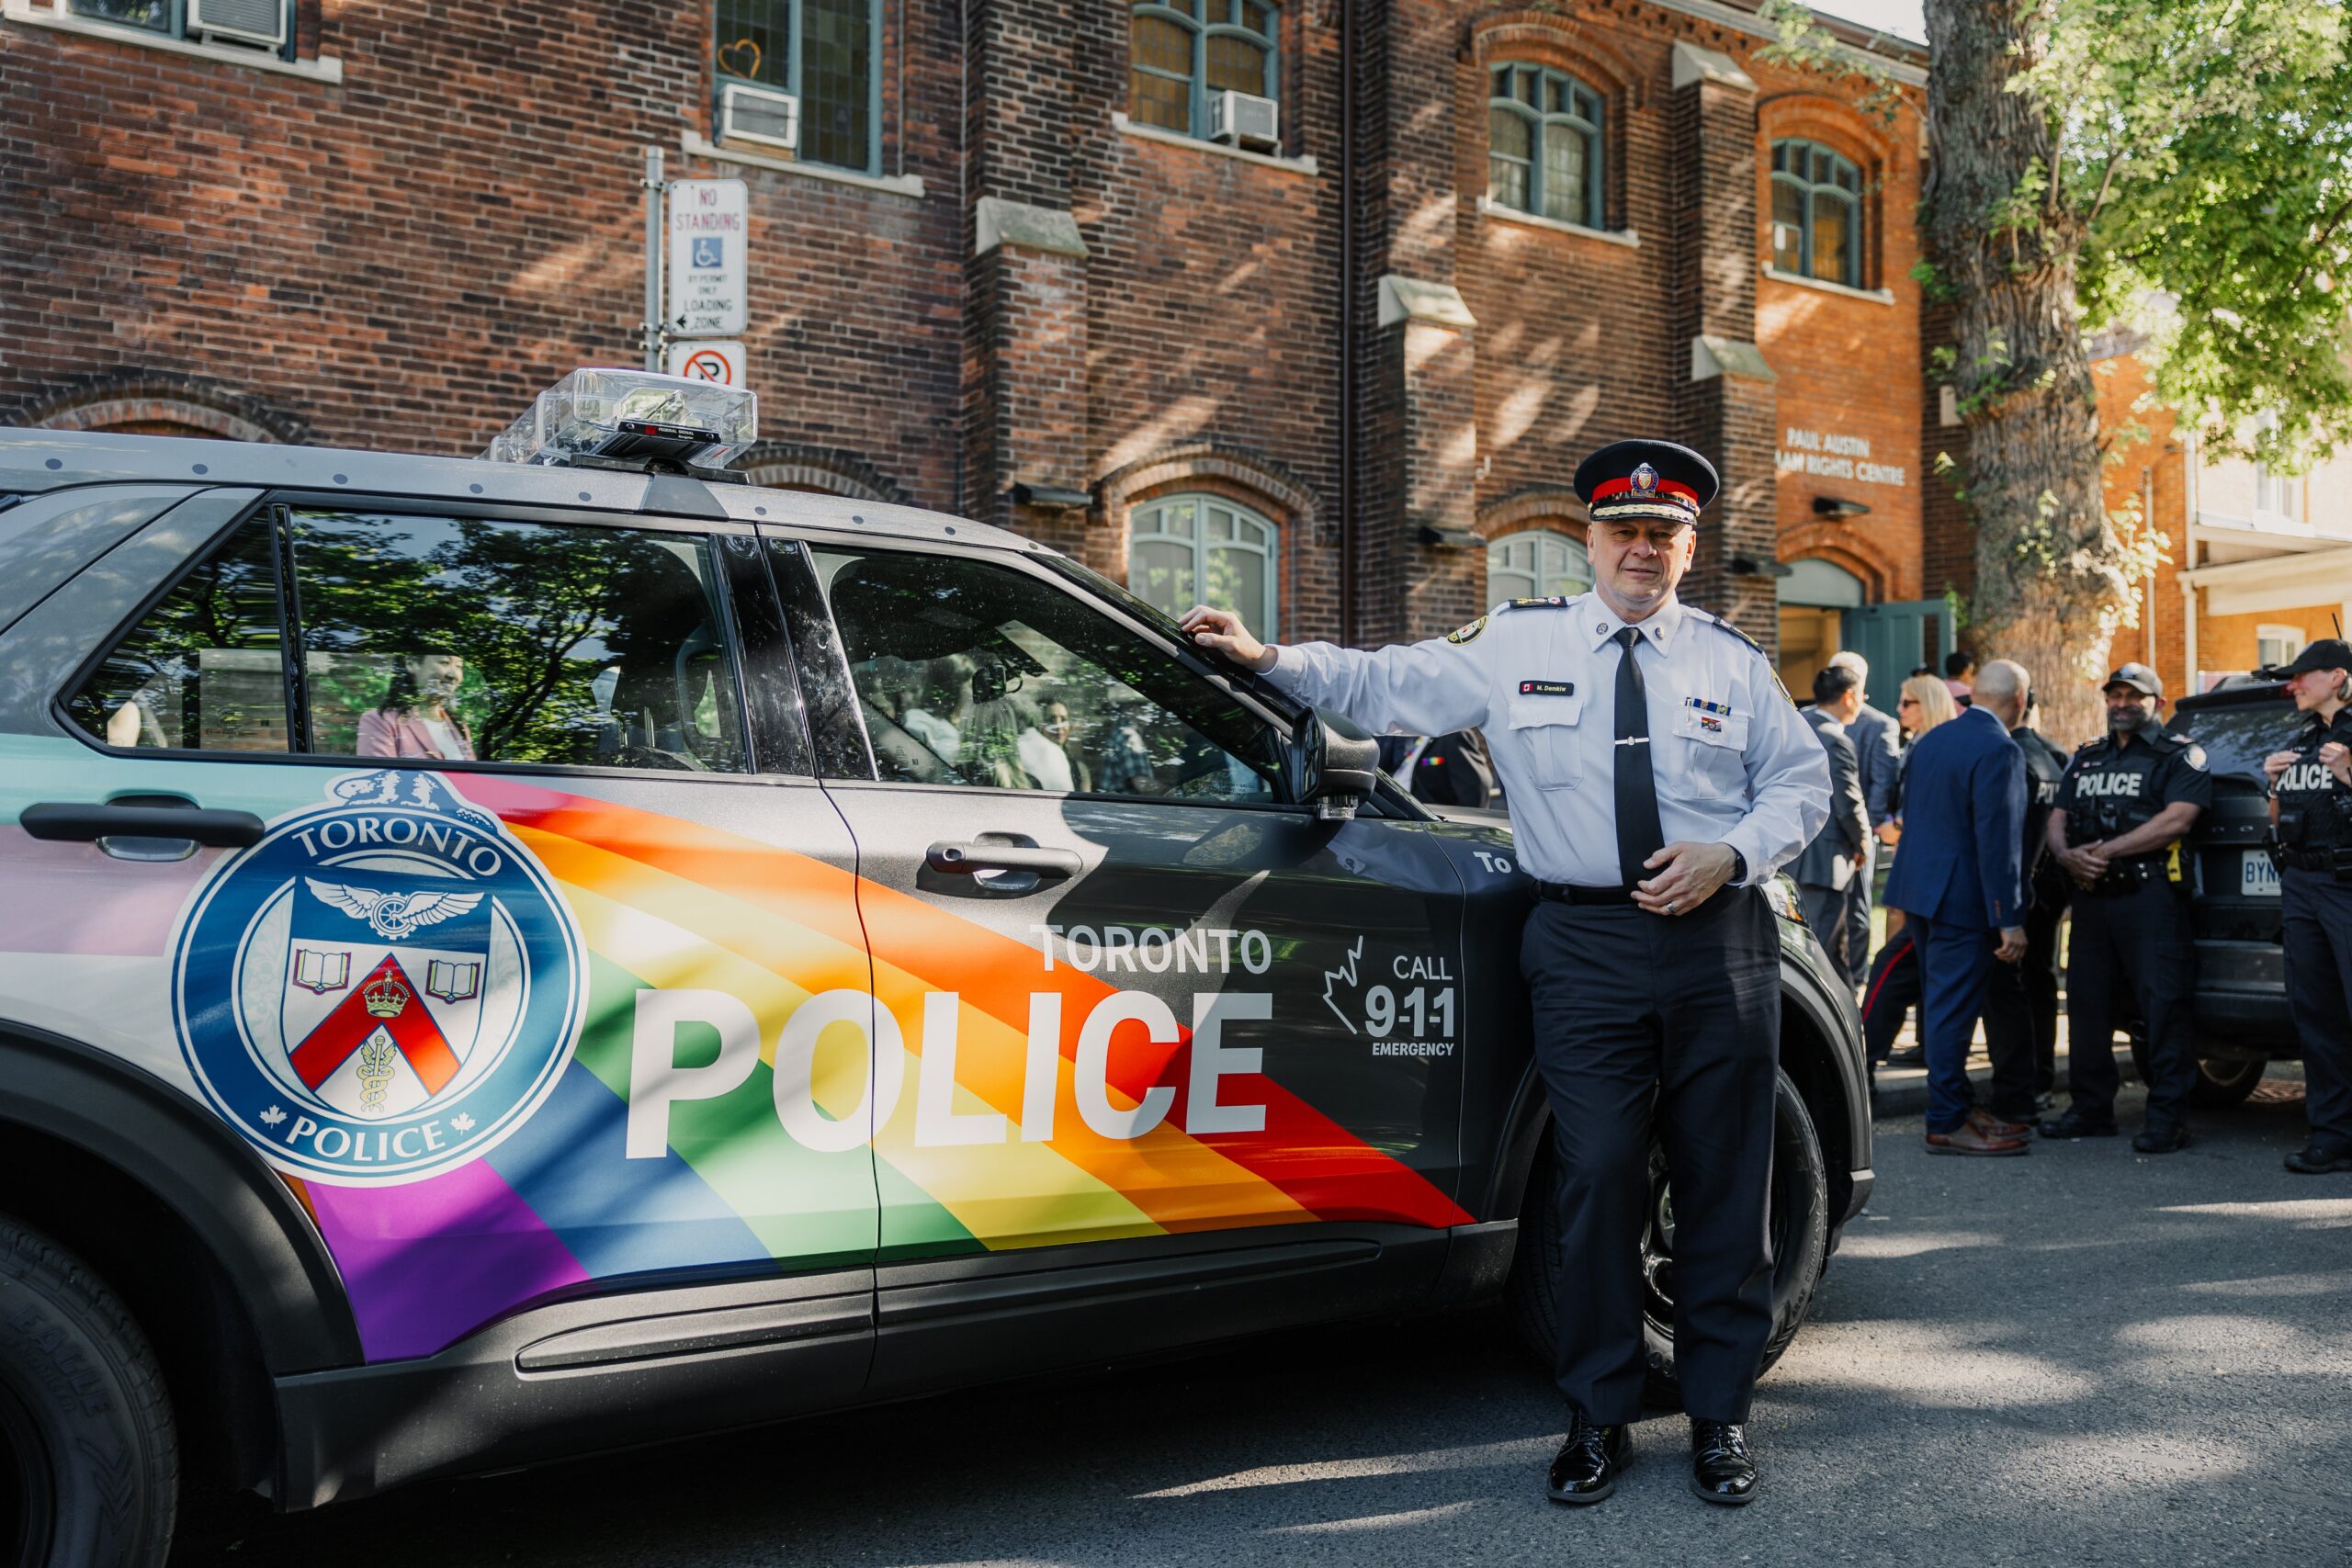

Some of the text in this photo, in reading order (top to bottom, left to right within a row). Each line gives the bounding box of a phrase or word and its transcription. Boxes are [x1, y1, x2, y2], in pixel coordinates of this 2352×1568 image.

[699, 189, 717, 207] NO
[675, 213, 741, 231] STANDING
[684, 299, 732, 312] LOADING
[695, 316, 722, 329] ZONE
[1786, 427, 1870, 457] PAUL AUSTIN
[1806, 453, 1854, 480] RIGHTS
[1856, 461, 1905, 487] CENTRE
[2075, 773, 2143, 798] POLICE
[291, 817, 503, 877] TORONTO
[1473, 852, 1512, 874] To
[2245, 862, 2281, 884] BYN
[1029, 923, 1272, 975] TORONTO
[1393, 955, 1453, 980] CALL
[1365, 985, 1454, 1038] 9-1-1
[1372, 1043, 1454, 1056] EMERGENCY
[626, 988, 1273, 1159] POLICE
[285, 1114, 447, 1162] POLICE
[9, 1304, 116, 1417] EAGLE
